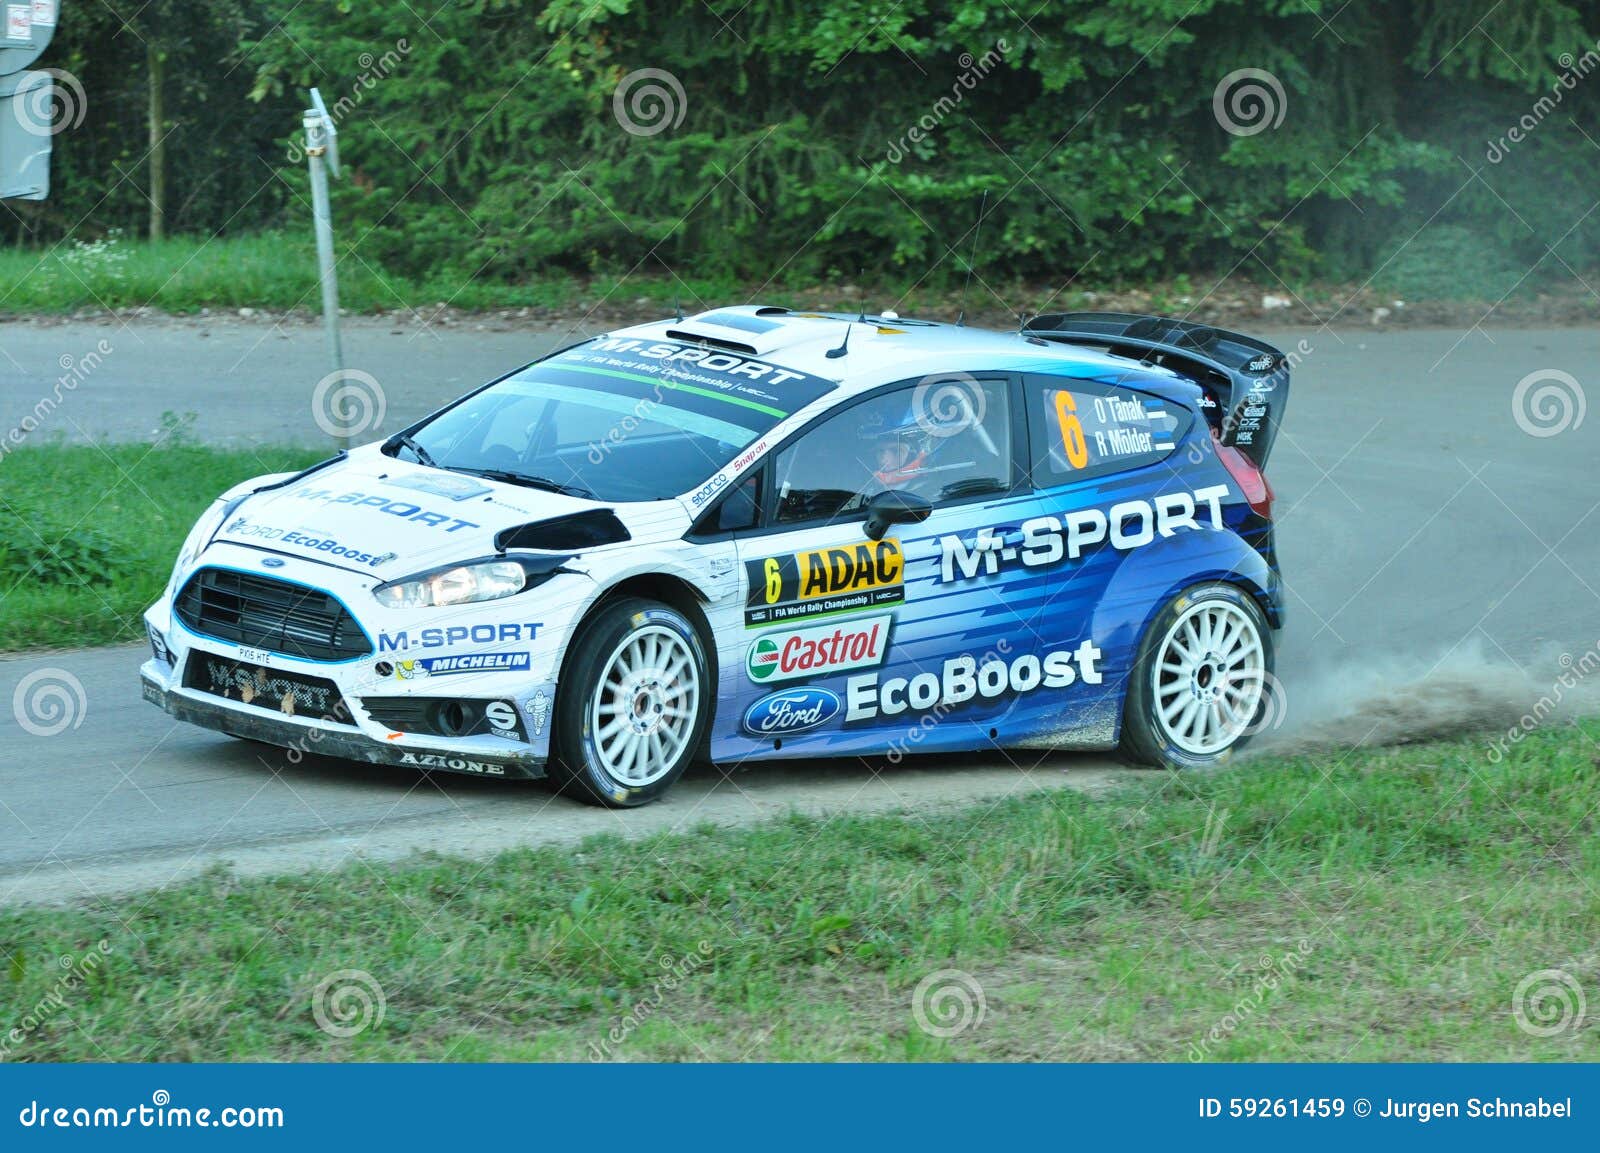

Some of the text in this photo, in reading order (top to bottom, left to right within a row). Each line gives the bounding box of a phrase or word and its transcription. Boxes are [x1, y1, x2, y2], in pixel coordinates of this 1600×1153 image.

[591, 339, 806, 385] M-SPORT
[1094, 398, 1106, 424] O
[1055, 390, 1088, 469] 6
[1094, 431, 1108, 457] R
[691, 473, 728, 507] sparco
[296, 487, 480, 533] M-SPORT
[281, 531, 384, 567] EcoBoost
[939, 484, 1231, 583] M-SPORT
[763, 541, 901, 605] 6 ADAC
[775, 608, 787, 618] FIA
[787, 603, 807, 615] World
[807, 602, 824, 613] Rally
[824, 595, 868, 610] Championship
[378, 622, 544, 652] M-SPORT
[780, 623, 880, 673] Castrol
[430, 653, 530, 671] MICHELIN
[845, 640, 1103, 722] EcoBoost
[761, 694, 823, 730] Ford
[399, 752, 505, 775] AZIONE
